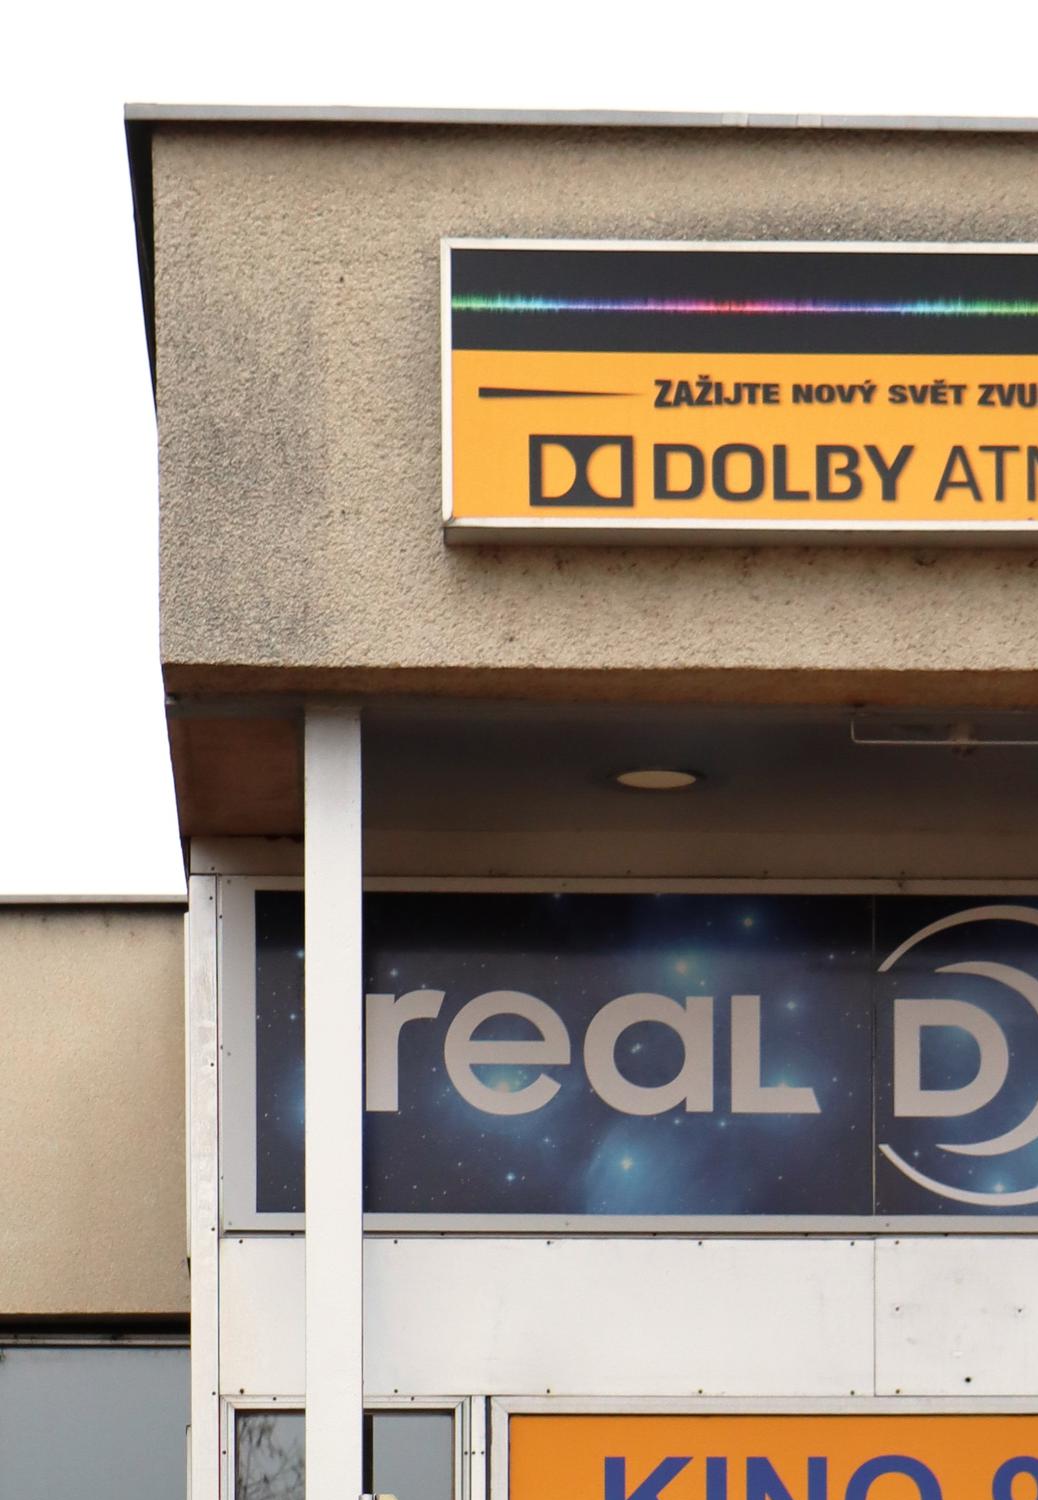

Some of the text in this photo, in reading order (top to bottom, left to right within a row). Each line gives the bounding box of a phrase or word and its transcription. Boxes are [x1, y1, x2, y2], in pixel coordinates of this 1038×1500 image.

[653, 375, 780, 408] ZAŽIJTE
[791, 380, 877, 405] NOVÝ
[887, 379, 968, 405] SVĚT
[653, 443, 916, 502] DOLBY
